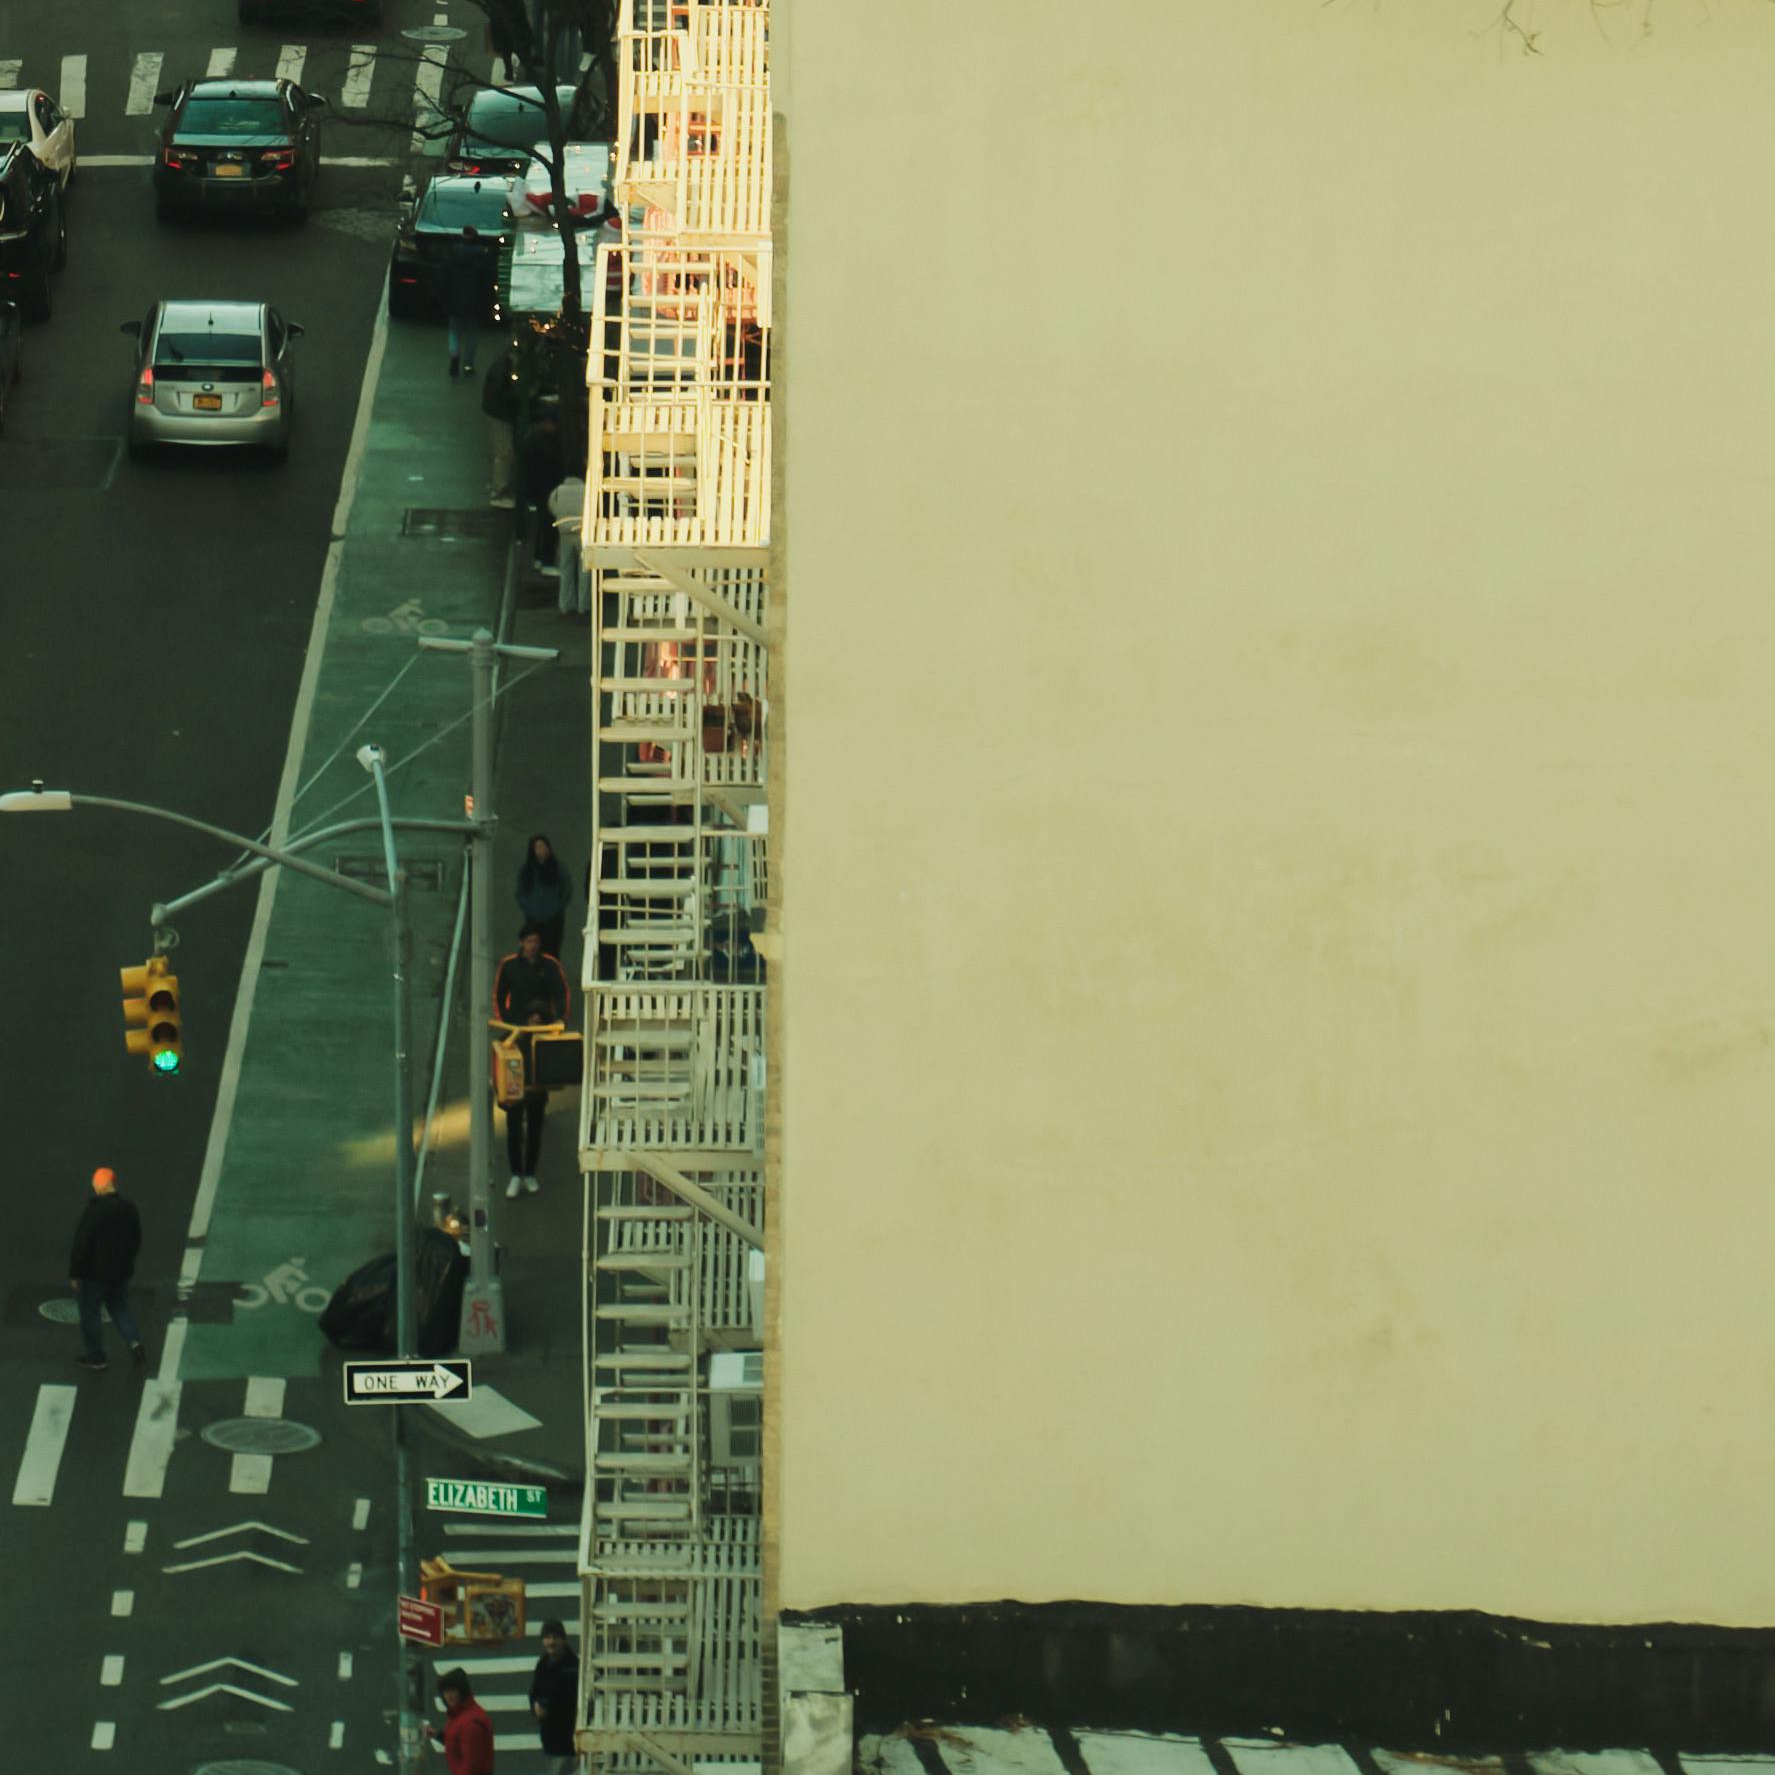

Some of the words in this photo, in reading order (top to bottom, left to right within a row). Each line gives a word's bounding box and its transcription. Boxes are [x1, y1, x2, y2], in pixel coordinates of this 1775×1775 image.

[364, 1375, 398, 1390] ONE
[416, 1374, 451, 1390] WAY
[427, 1481, 519, 1512] ELIZABETH
[526, 1489, 543, 1503] ST
